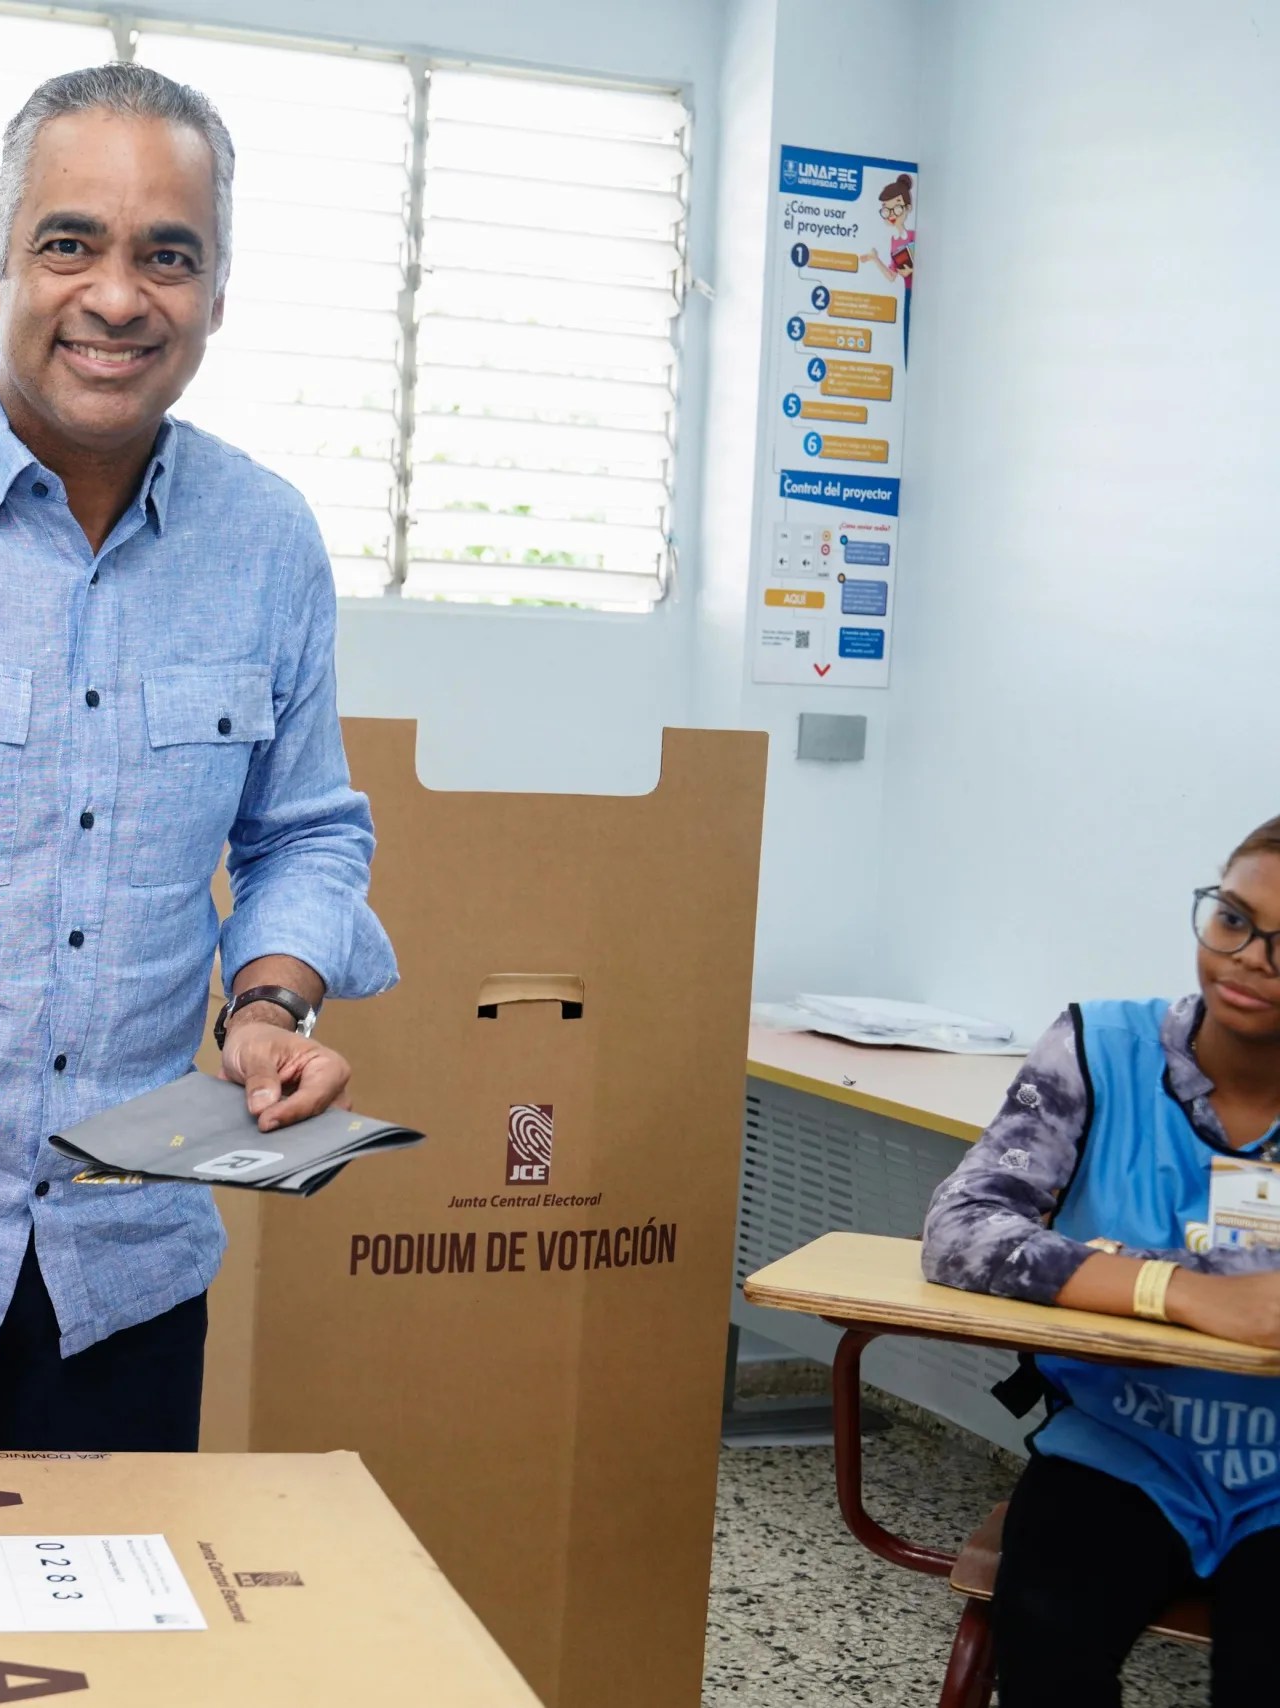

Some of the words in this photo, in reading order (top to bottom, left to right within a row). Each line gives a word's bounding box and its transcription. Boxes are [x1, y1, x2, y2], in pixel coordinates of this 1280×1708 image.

[799, 163, 858, 183] UNAPEC
[798, 177, 838, 189] UNIVERSIDAD
[839, 182, 857, 191] APEC
[784, 200, 821, 216] ¿Cómo
[824, 208, 846, 219] usar
[783, 216, 794, 229] el
[797, 220, 859, 238] proyector?
[795, 248, 803, 263] 1
[816, 290, 826, 308] 2
[791, 321, 801, 337] 3
[811, 361, 822, 378] 4
[787, 397, 797, 414] 5
[807, 435, 818, 453] 6
[784, 479, 823, 496] Control
[824, 481, 841, 497] del
[843, 486, 892, 502] proyector
[784, 591, 807, 604] AQUÍ
[214, 1154, 261, 1169] R
[508, 1163, 546, 1181] JCE
[448, 1194, 488, 1208] Junta
[490, 1193, 540, 1208] Central
[542, 1191, 602, 1208] Electoral
[350, 1232, 475, 1276] PODIUM
[486, 1230, 526, 1273] DE
[537, 1216, 677, 1272] VOTACIÓN
[197, 1541, 218, 1561] Junta
[208, 1562, 234, 1588] Central
[220, 1588, 252, 1624] Electoral
